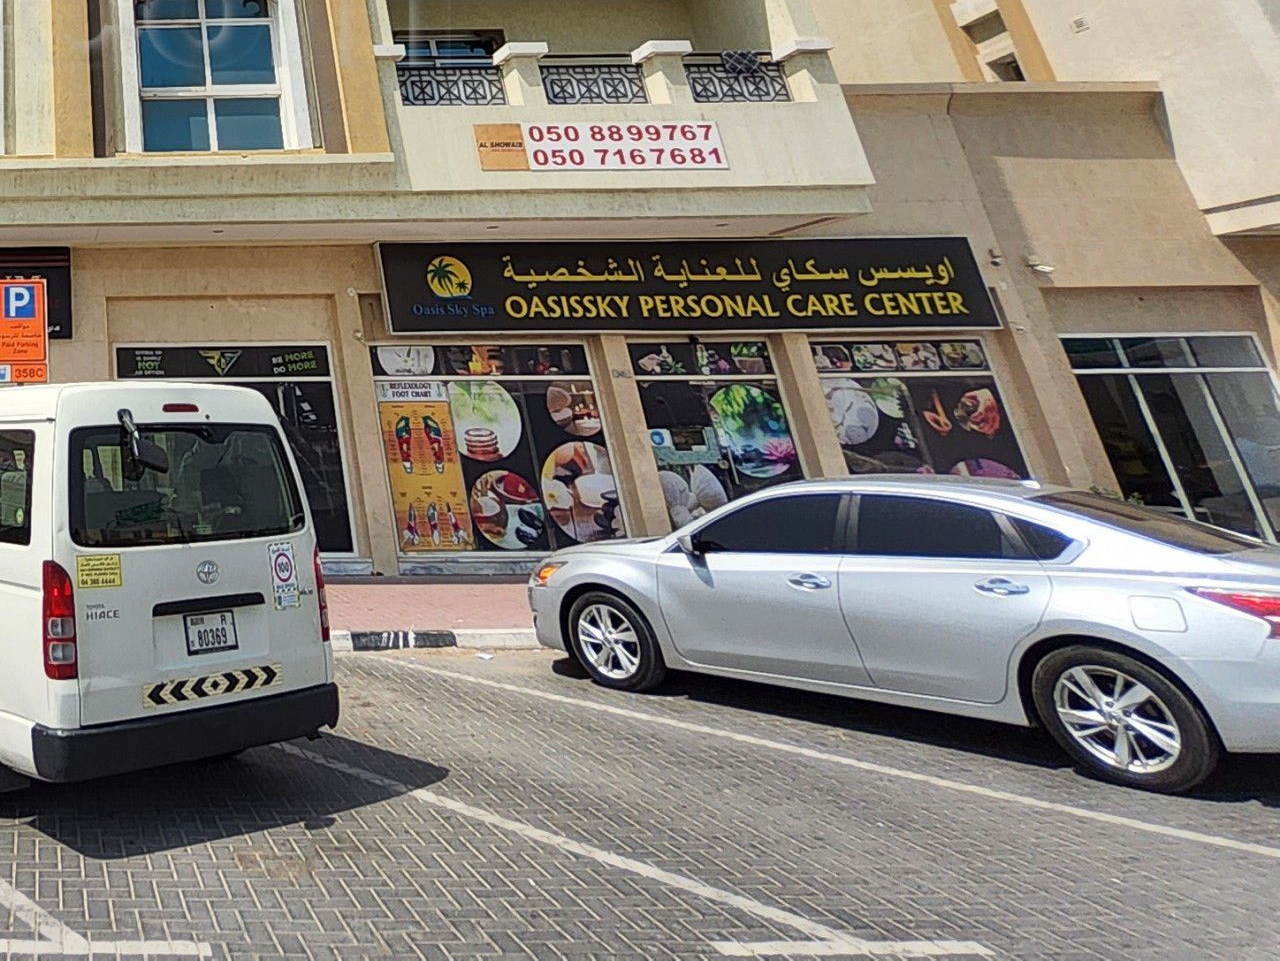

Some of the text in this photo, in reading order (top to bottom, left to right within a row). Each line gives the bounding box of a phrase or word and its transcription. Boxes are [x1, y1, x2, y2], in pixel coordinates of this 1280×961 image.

[528, 124, 713, 142] 050 8899767
[479, 141, 489, 149] AL
[533, 147, 723, 166] 050 7167681
[502, 254, 644, 289] الشخصية
[653, 253, 762, 288] للعناية
[773, 257, 850, 291] سكاي
[9, 286, 30, 317] P
[412, 302, 496, 318] Oasis Sky Spa
[505, 291, 970, 318] OASISSKY PERSONAL CARE CENTER
[138, 361, 161, 370] NOT
[284, 351, 315, 363] MORE
[14, 368, 44, 378] 358C
[273, 360, 318, 374] DO MORE
[392, 390, 409, 398] FOOT
[86, 610, 120, 620] HIACE
[197, 626, 228, 648] 80369
